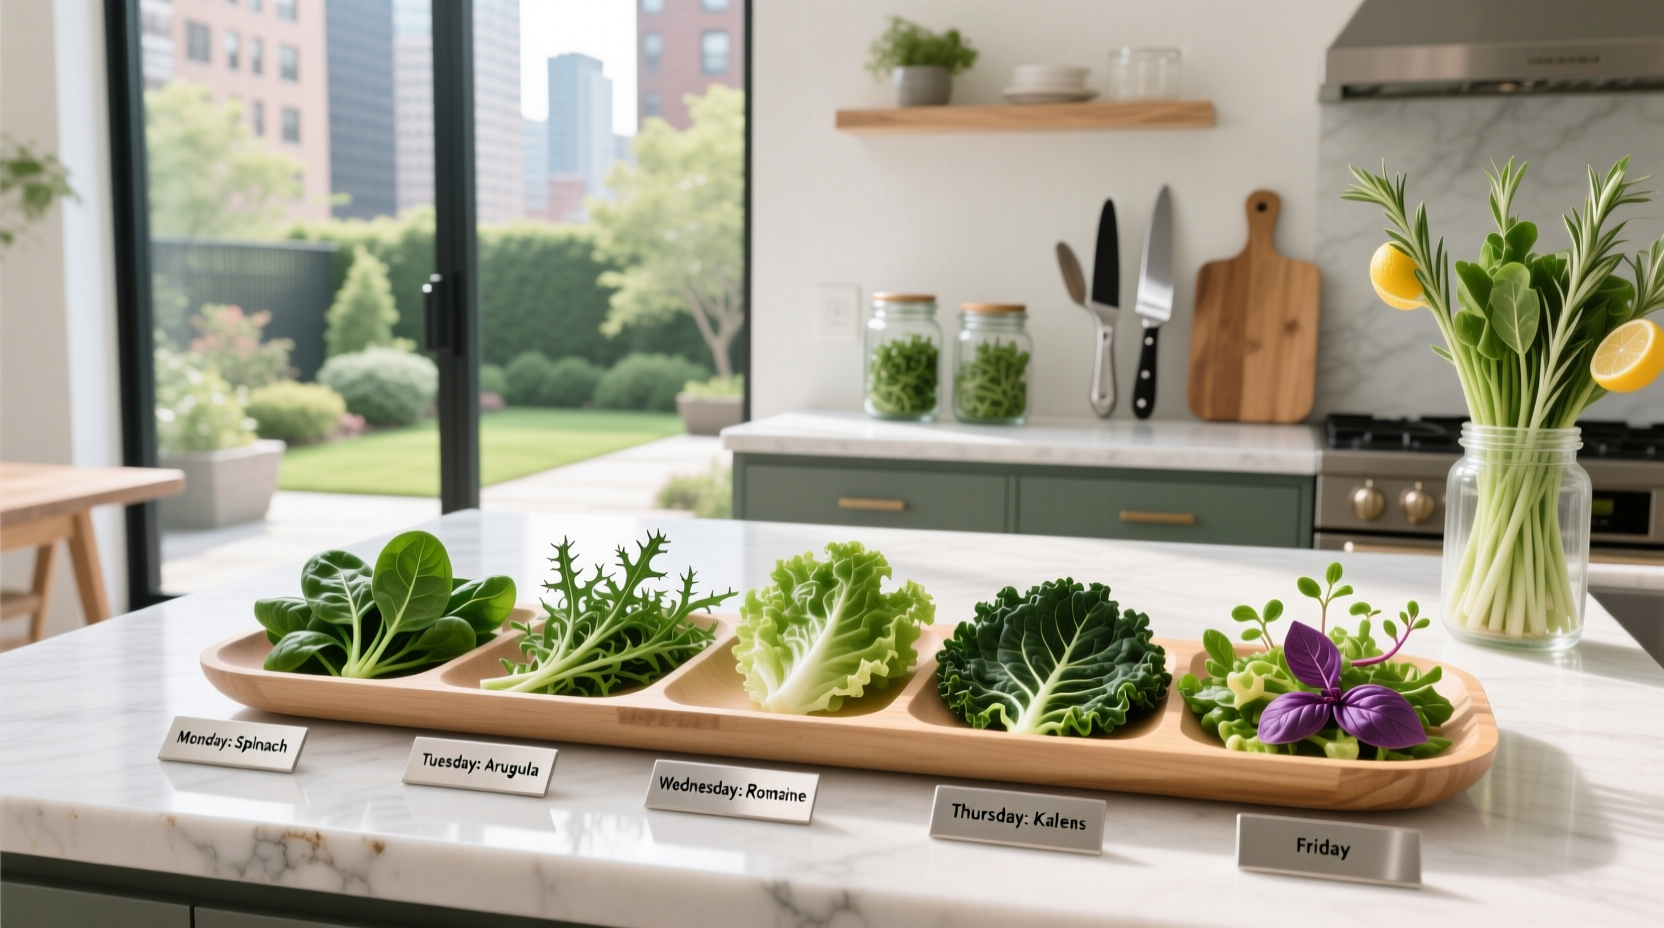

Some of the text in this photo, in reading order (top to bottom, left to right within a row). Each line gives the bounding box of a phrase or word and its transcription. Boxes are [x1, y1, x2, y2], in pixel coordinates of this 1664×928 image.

[177, 730, 233, 751] Monday:
[423, 753, 539, 779] Tuesday: Arugula
[659, 776, 807, 802] Wednesday: Romaine
[952, 803, 1087, 831] Thursday: Kalens
[1296, 837, 1352, 861] Friday
